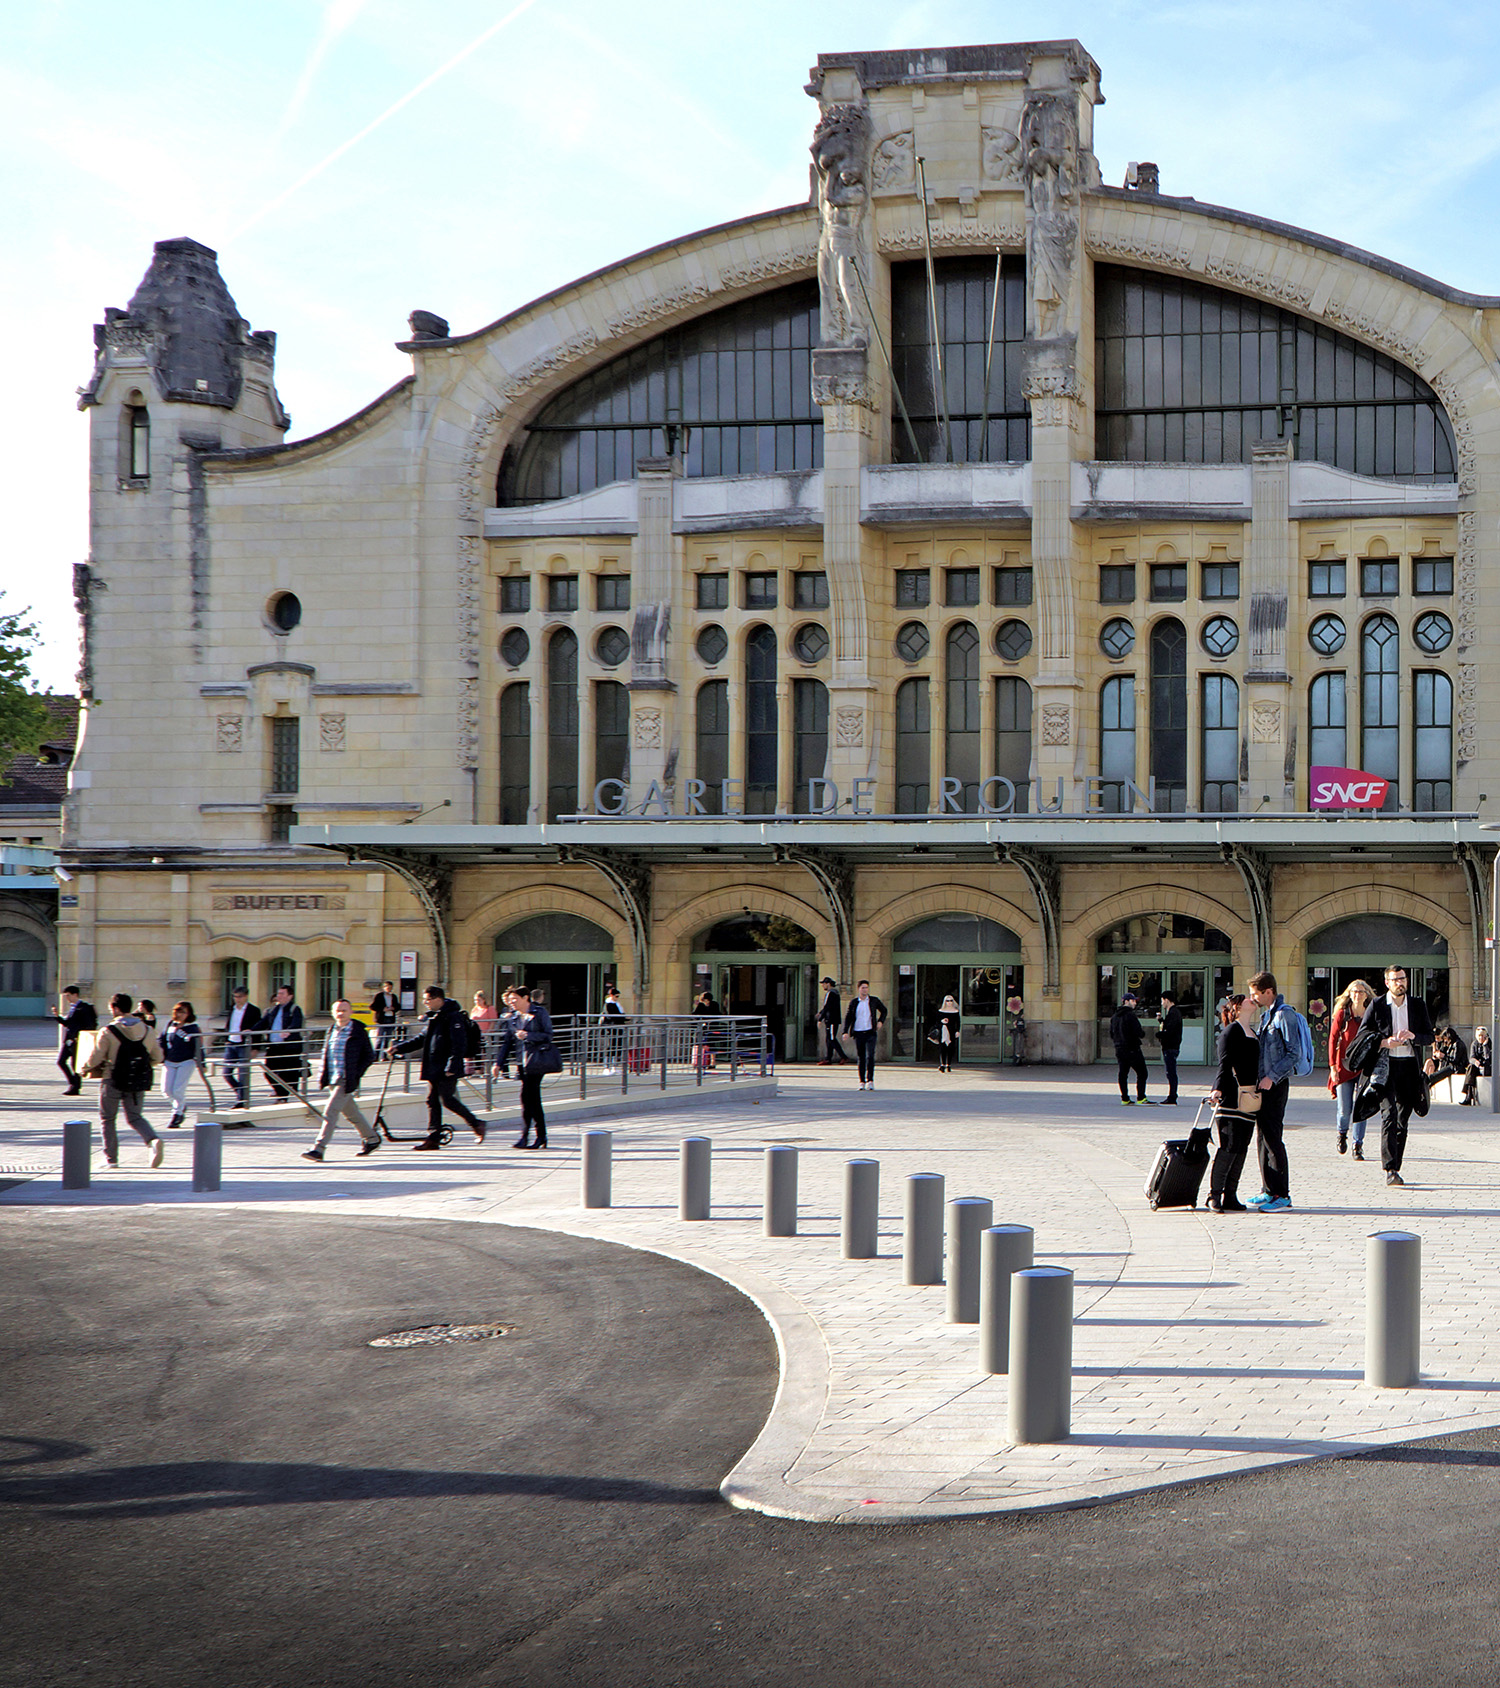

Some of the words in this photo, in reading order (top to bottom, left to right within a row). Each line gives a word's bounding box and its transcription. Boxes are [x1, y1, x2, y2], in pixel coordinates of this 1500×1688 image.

[594, 777, 743, 815] GARE
[808, 777, 873, 815] DE
[939, 775, 1156, 813] ROUEN
[1313, 782, 1385, 804] SNCF
[234, 895, 325, 910] BUFFET
